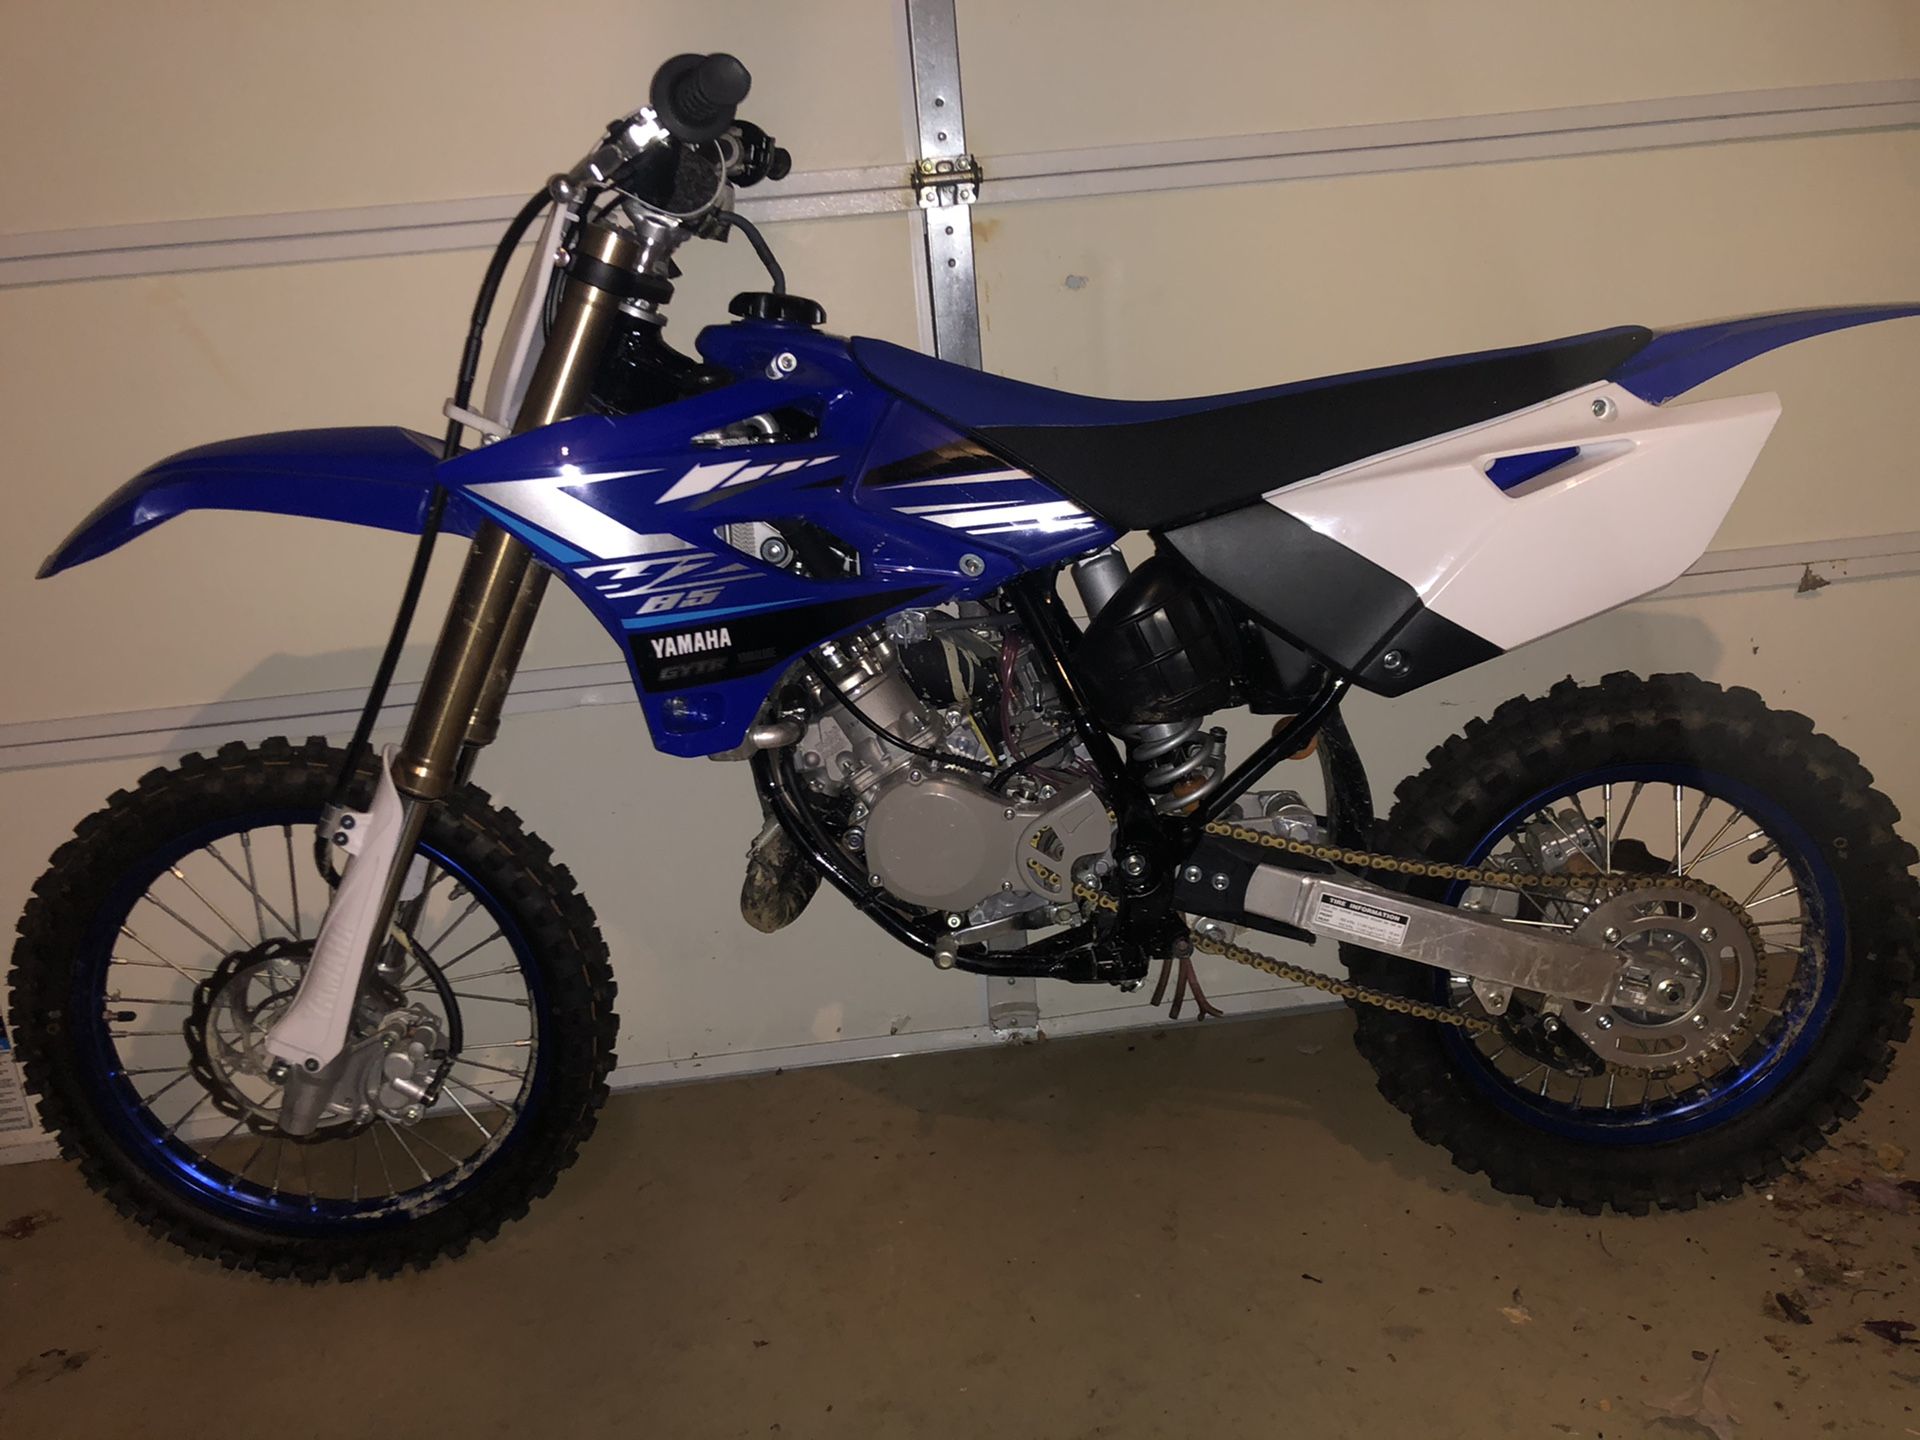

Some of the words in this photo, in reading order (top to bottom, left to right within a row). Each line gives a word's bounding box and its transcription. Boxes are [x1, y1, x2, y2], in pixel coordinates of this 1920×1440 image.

[635, 586, 726, 615] 85
[650, 627, 732, 659] YAMAHA
[1329, 897, 1346, 908] TIRE
[1348, 903, 1401, 922] INFORMATION
